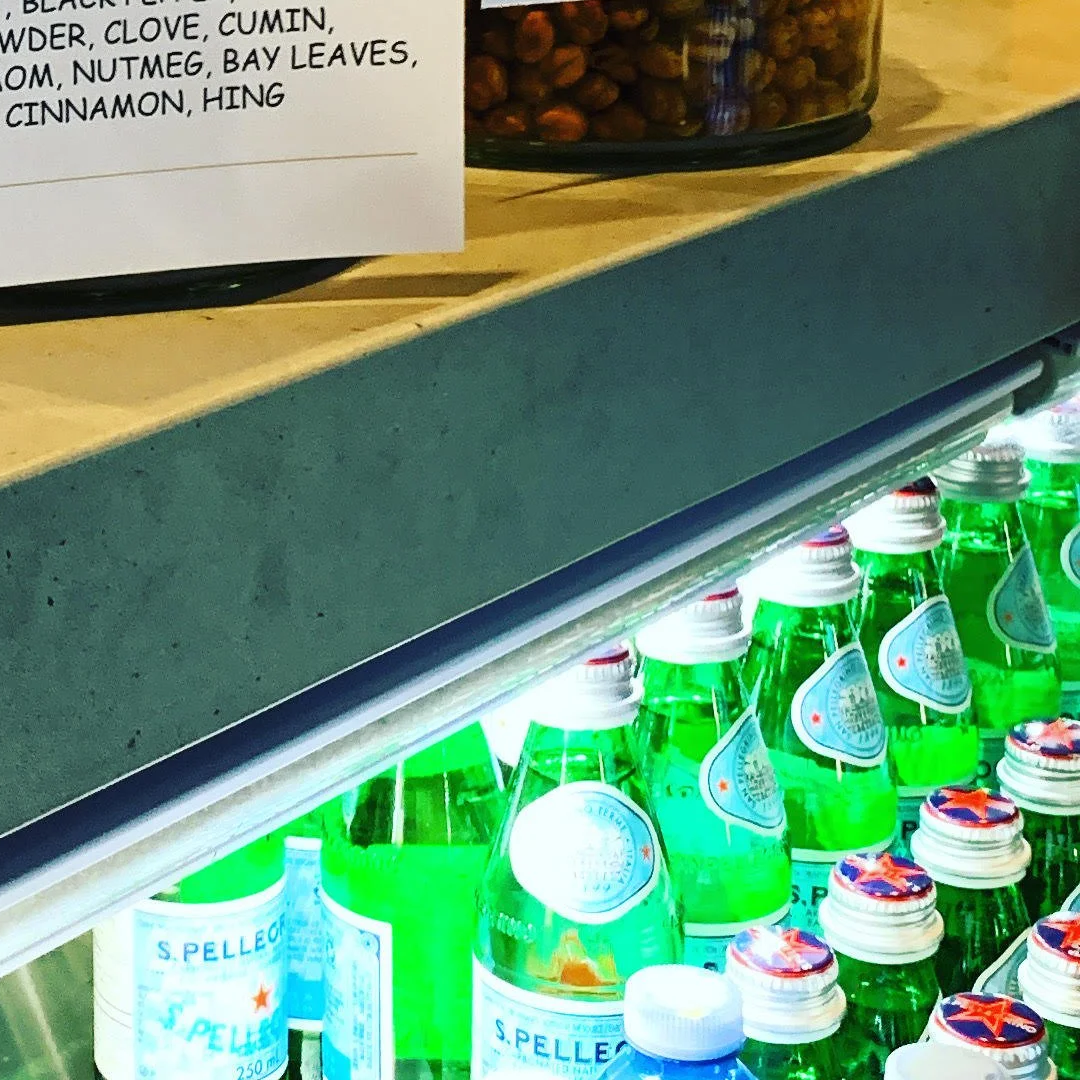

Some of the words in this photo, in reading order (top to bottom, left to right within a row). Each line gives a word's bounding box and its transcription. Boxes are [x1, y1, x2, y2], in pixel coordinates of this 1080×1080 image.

[104, 13, 208, 44] CLOVE,
[219, 7, 334, 36] CUMIN,
[73, 51, 211, 85] NUTMEG,
[223, 46, 280, 73] BAY
[291, 39, 417, 70] LEAVES,
[6, 89, 192, 127] CINNAMON,
[203, 82, 285, 112] HING
[236, 1059, 263, 1080] 250
